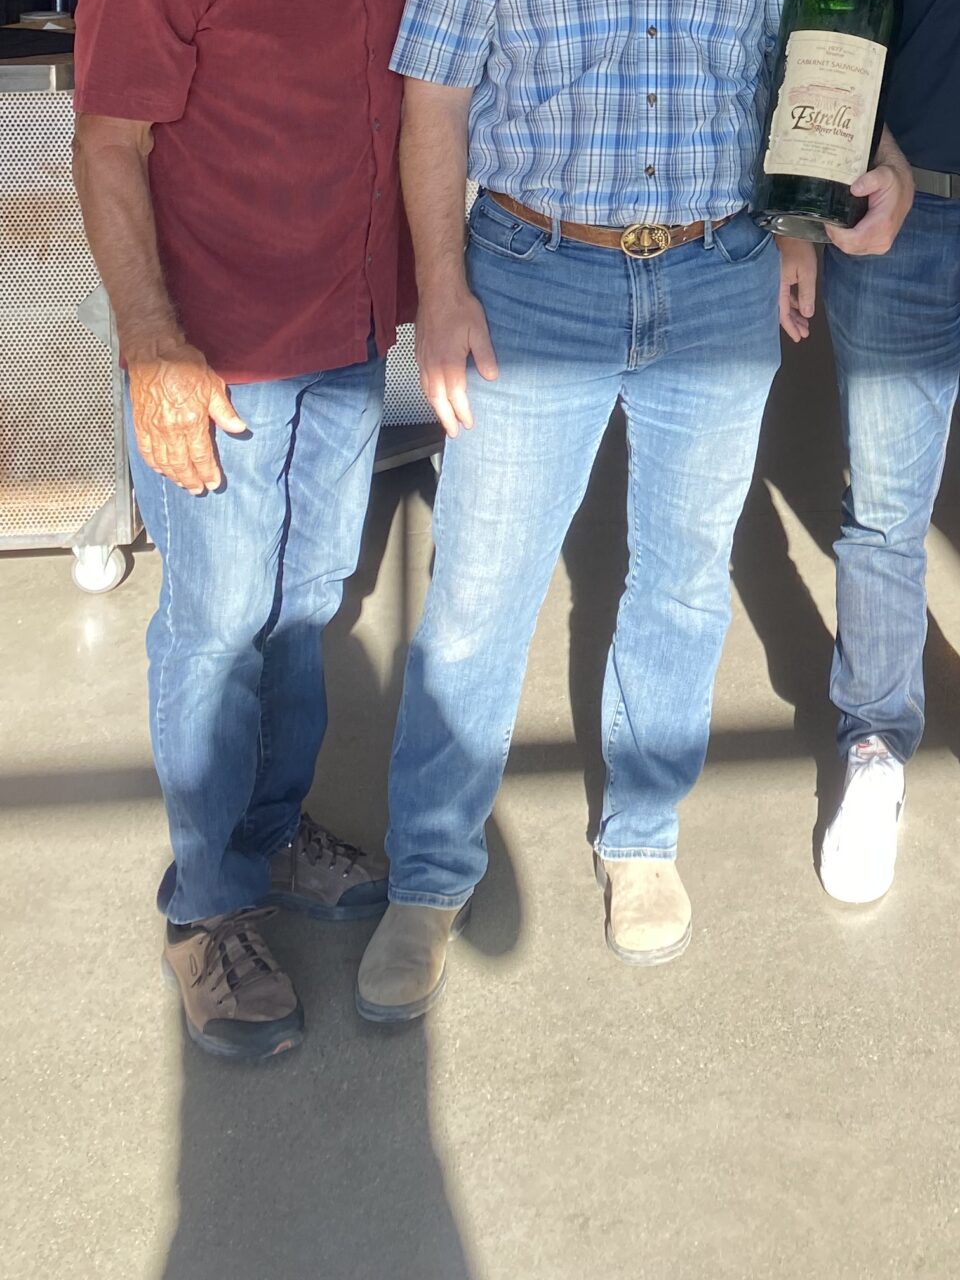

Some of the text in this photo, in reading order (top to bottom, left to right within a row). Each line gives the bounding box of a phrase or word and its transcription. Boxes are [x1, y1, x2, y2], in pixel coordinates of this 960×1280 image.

[791, 105, 852, 131] Estrella
[815, 124, 854, 142] River Winery
